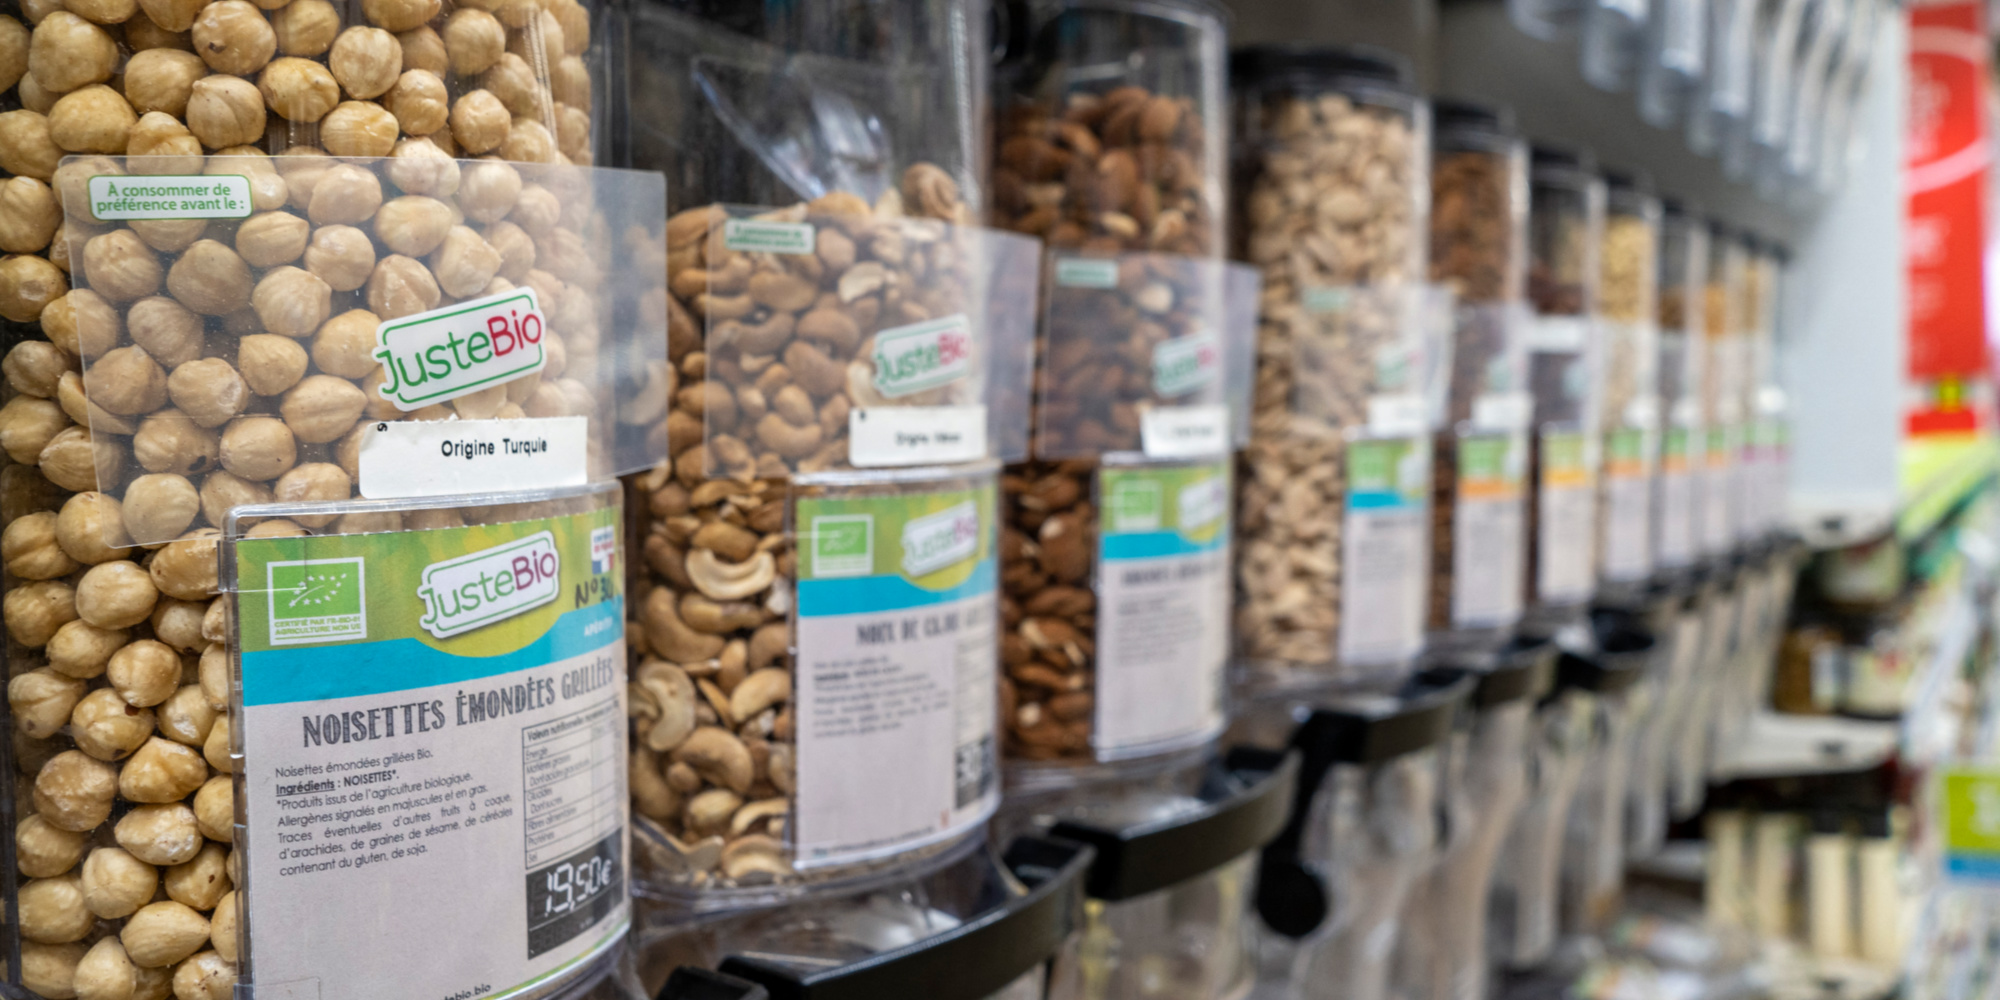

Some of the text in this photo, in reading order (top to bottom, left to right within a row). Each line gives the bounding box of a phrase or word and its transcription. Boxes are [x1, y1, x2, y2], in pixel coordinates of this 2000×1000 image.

[97, 198, 177, 215] préférence
[181, 199, 221, 211] avant
[224, 197, 237, 210] le
[108, 182, 231, 197] À consommer de
[376, 309, 542, 395] JusteBio
[441, 437, 548, 459] Origine Turquie
[421, 550, 556, 625] JusteBio
[302, 656, 614, 748] NOISETTES ÉMONDÉES GRILLÉES
[275, 748, 433, 778] Noisettes émondées grillées Bio.
[276, 778, 335, 796] Ingrédients
[325, 794, 347, 805] issus
[349, 791, 363, 802] de
[365, 781, 422, 800] l'agriculture
[424, 773, 473, 789] biologique.
[278, 812, 333, 827] Allergènes
[335, 805, 375, 822] signalés
[377, 804, 390, 814] en
[393, 793, 442, 811] majuscules
[444, 790, 453, 801] et
[455, 788, 467, 799] en
[278, 831, 313, 844] Traces
[324, 821, 382, 838] éventuelles
[392, 812, 431, 828] d'autres
[441, 805, 460, 817] fruits
[469, 800, 476, 811] à
[351, 839, 365, 850] de
[369, 833, 405, 849] graines
[408, 829, 421, 840] de
[464, 816, 477, 827] de
[480, 807, 513, 823] céréales
[280, 858, 336, 876] contenant
[338, 857, 352, 868] du
[391, 848, 404, 859] de
[406, 843, 428, 856] soja.
